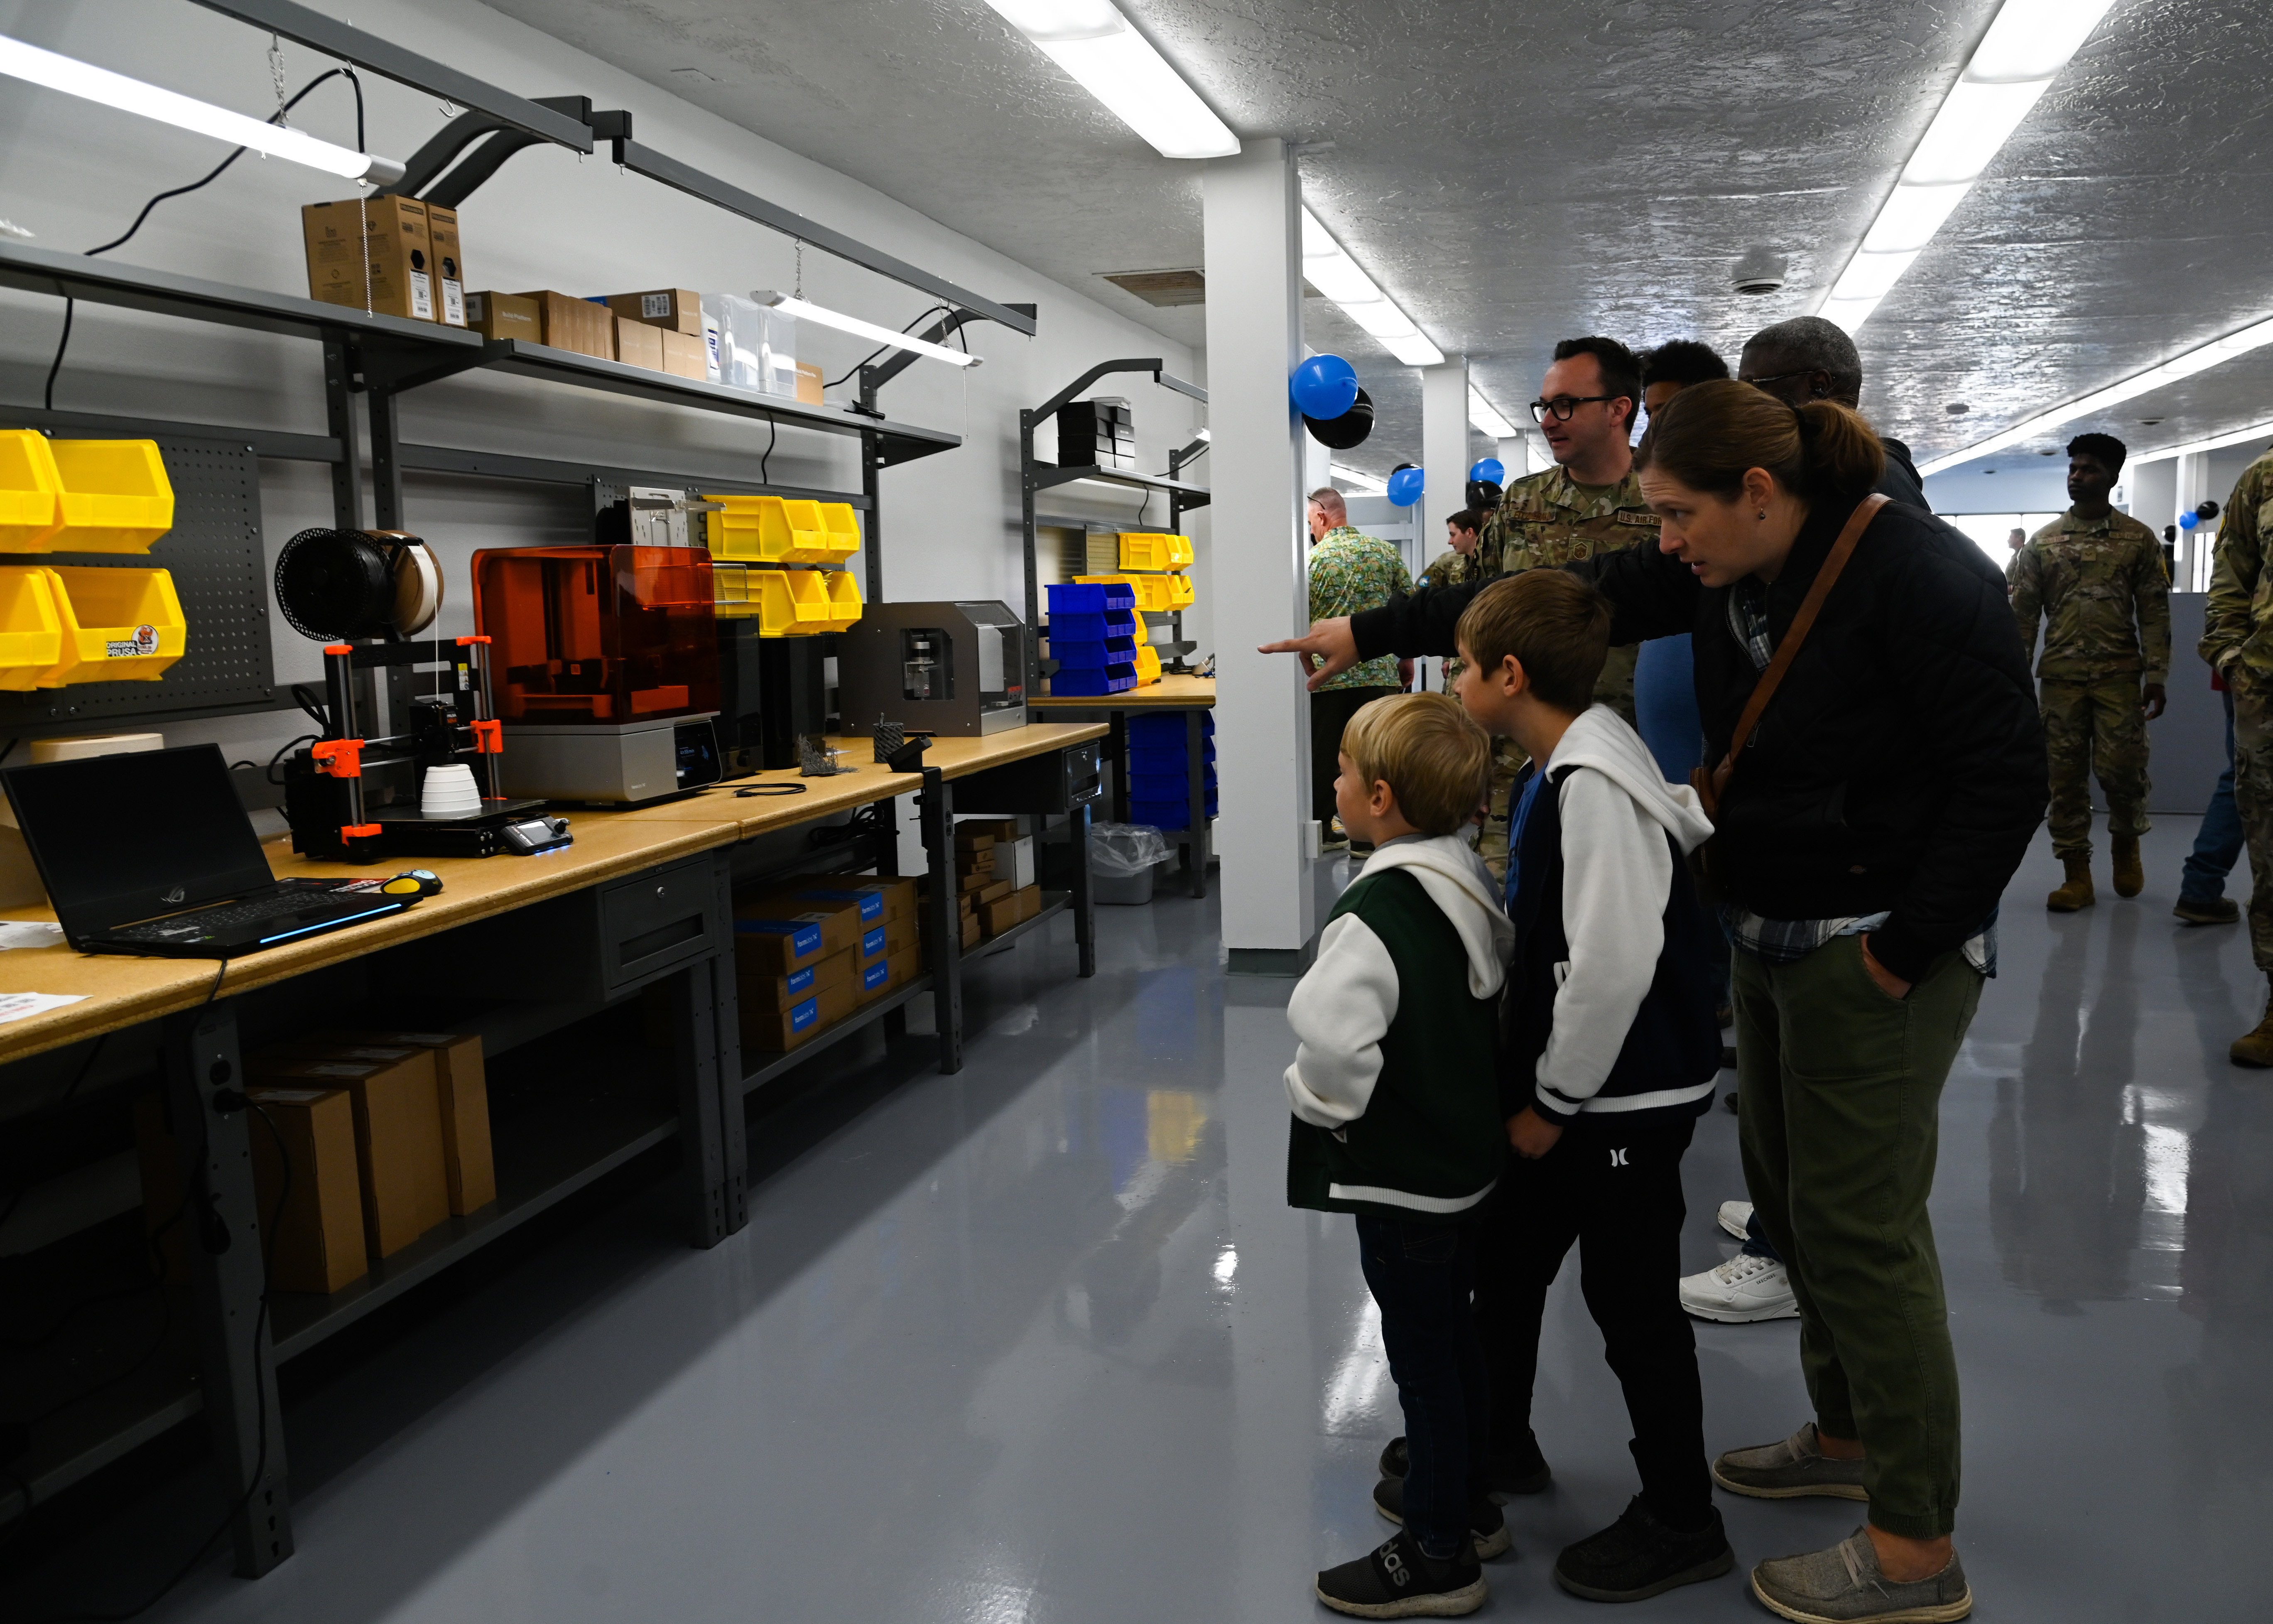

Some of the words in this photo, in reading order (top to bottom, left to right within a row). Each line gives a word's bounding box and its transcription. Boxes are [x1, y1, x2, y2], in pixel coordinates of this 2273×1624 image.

[1621, 513, 1632, 523] U.S.
[1635, 515, 1647, 524] AIR
[107, 648, 137, 657] PRUSA
[1756, 1273, 1776, 1285] SKECHERS
[1379, 1541, 1410, 1586] das
